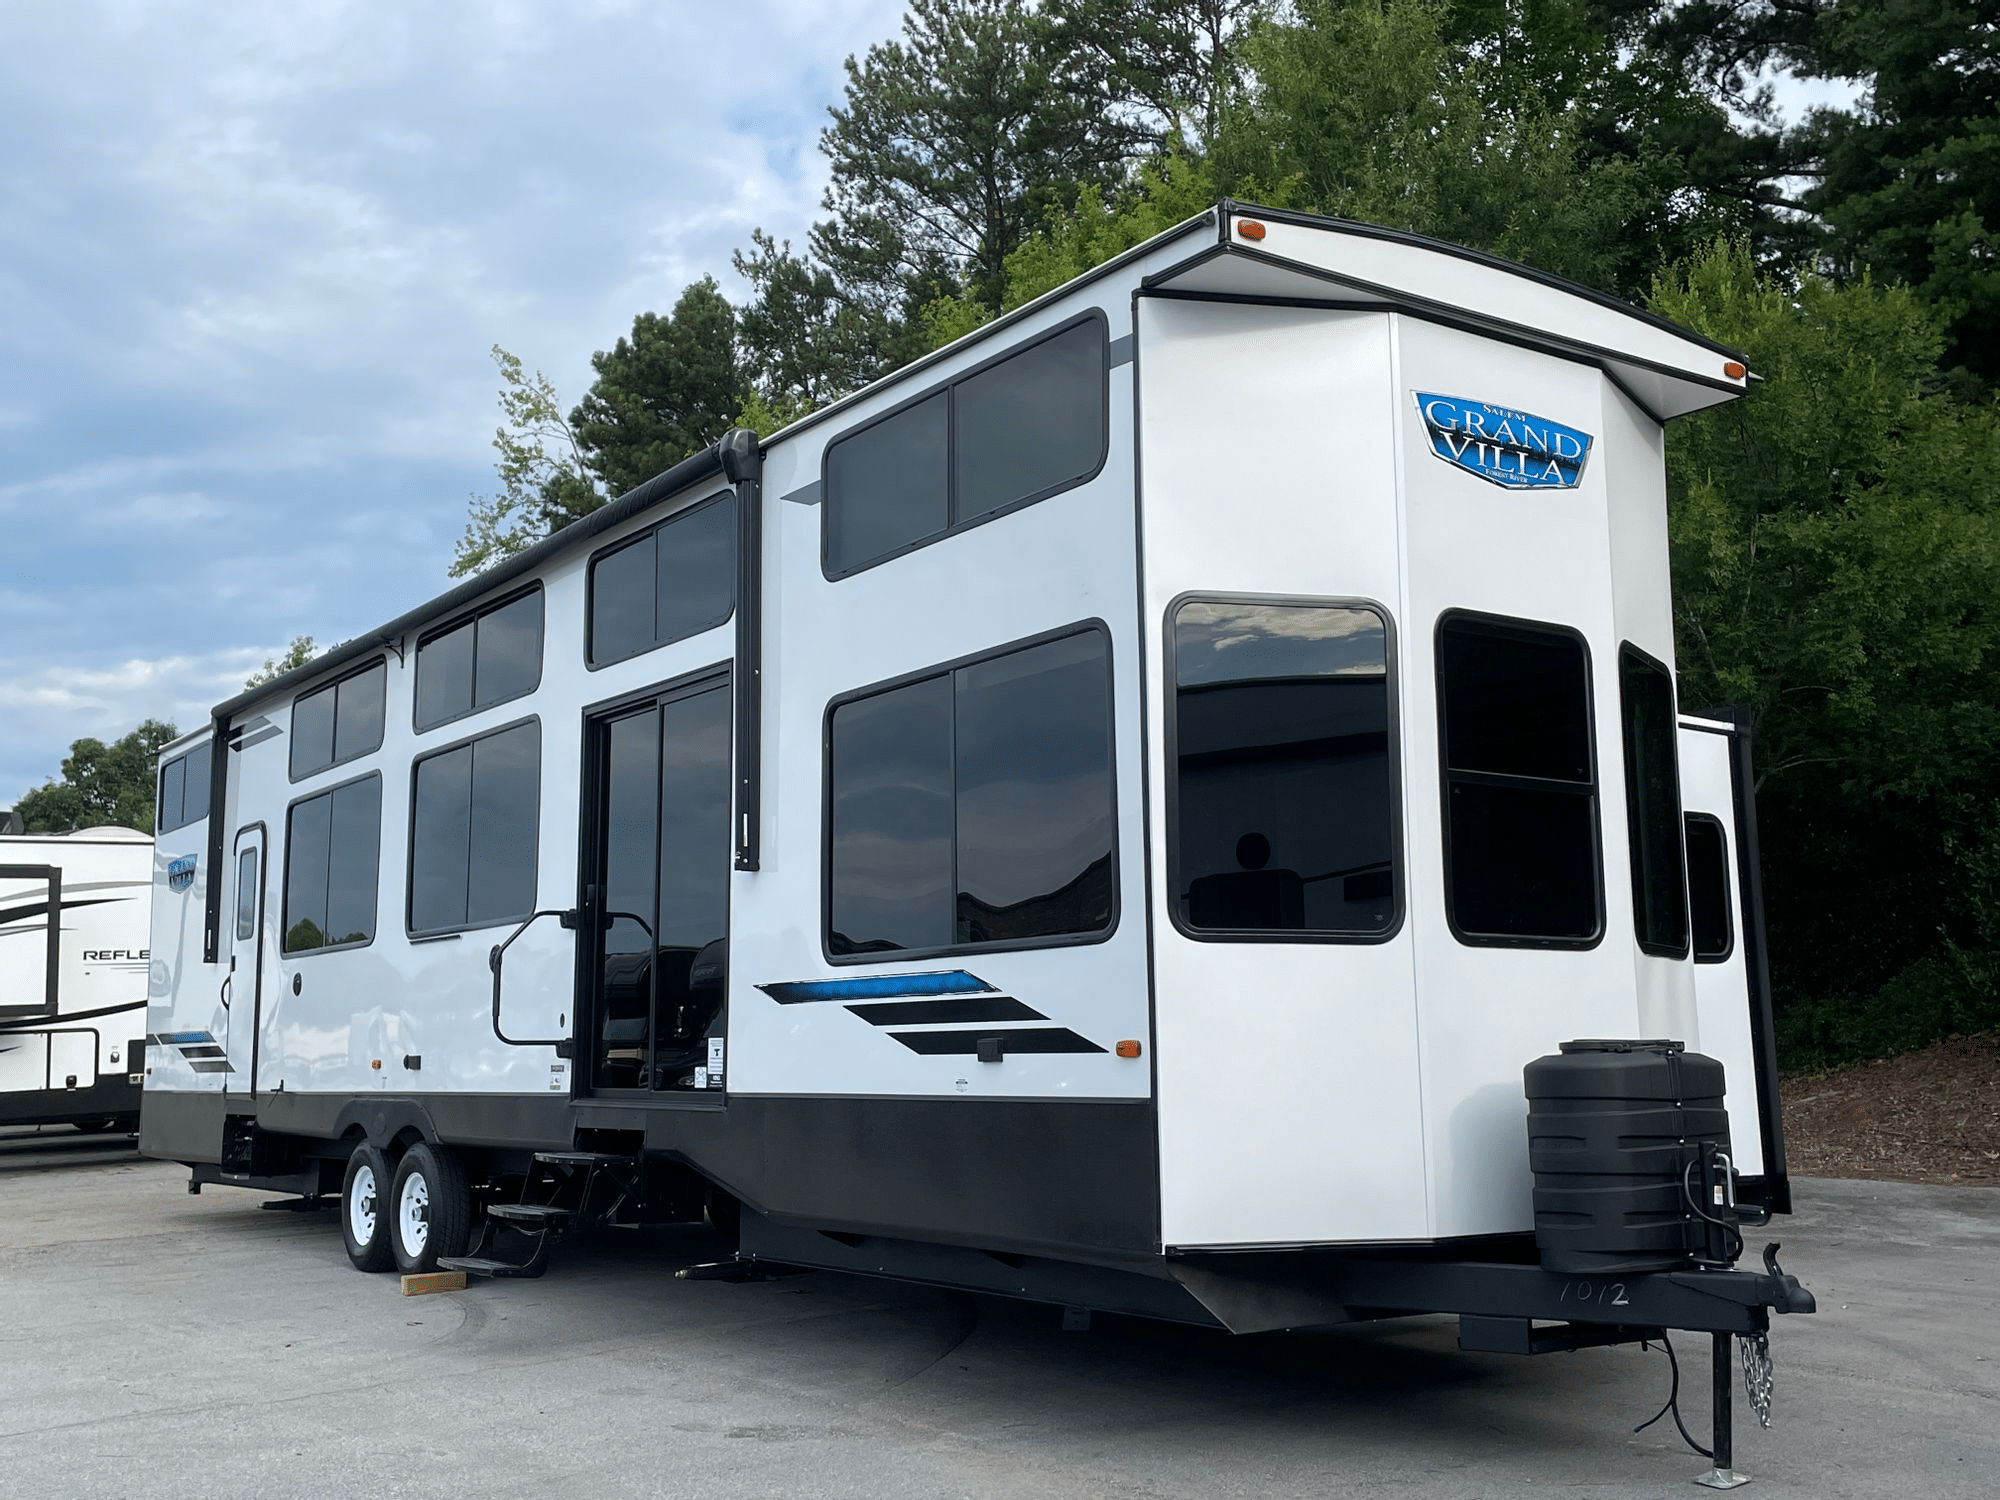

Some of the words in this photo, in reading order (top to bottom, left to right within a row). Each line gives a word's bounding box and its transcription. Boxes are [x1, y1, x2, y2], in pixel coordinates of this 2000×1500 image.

[1426, 400, 1582, 459] GRAND
[1439, 430, 1567, 485] VILLA
[83, 949, 150, 961] REFLE
[1560, 1280, 1630, 1306] 1012
